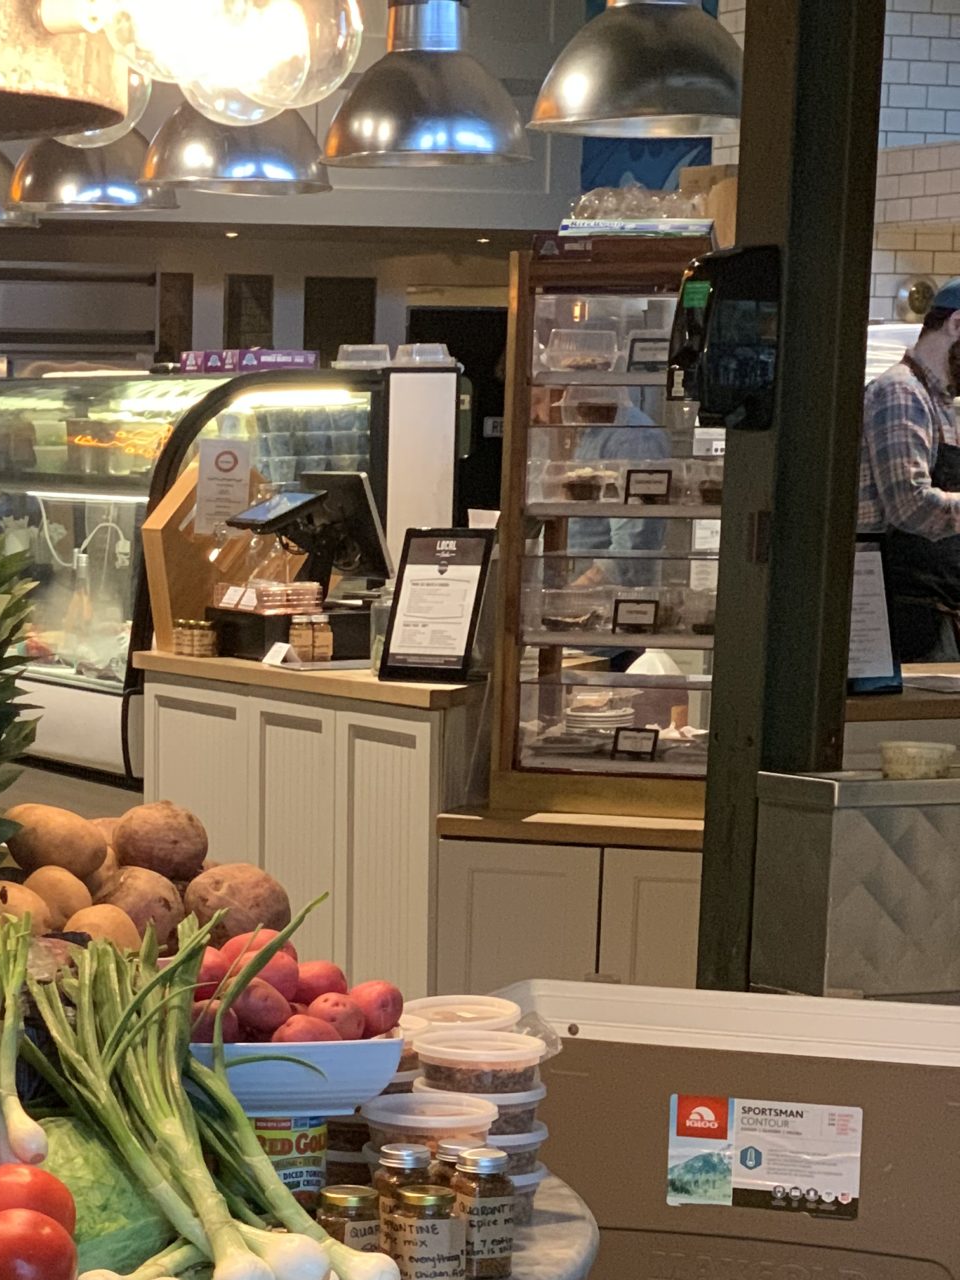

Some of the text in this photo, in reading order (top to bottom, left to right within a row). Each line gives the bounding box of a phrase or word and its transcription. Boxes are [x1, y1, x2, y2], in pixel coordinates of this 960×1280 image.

[741, 1106, 804, 1119] SPORTSMAN
[686, 1119, 718, 1129] IGLOO
[740, 1116, 790, 1128] CONTOUR
